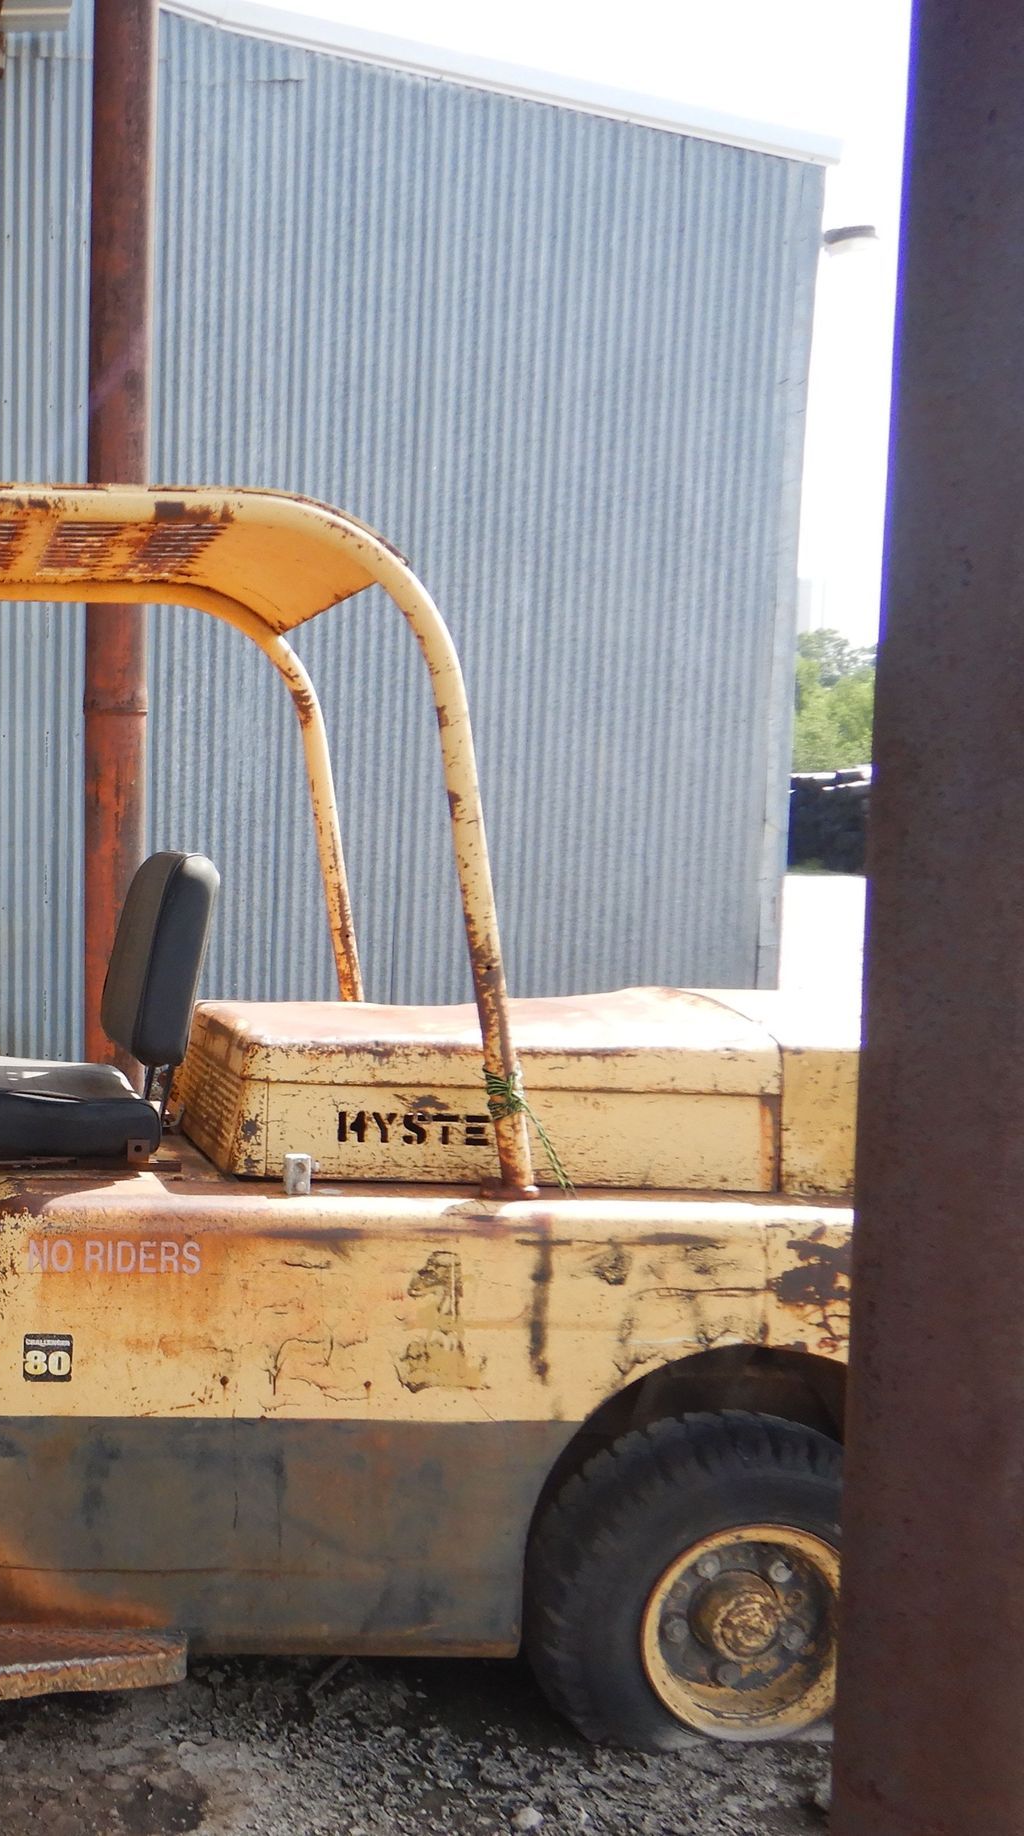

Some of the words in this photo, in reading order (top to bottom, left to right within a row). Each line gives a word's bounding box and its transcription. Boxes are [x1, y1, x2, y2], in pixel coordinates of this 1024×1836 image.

[337, 1110, 492, 1146] HYSTE
[28, 1239, 73, 1272] NO
[85, 1240, 202, 1274] RIDERS
[24, 1350, 71, 1376] 80
